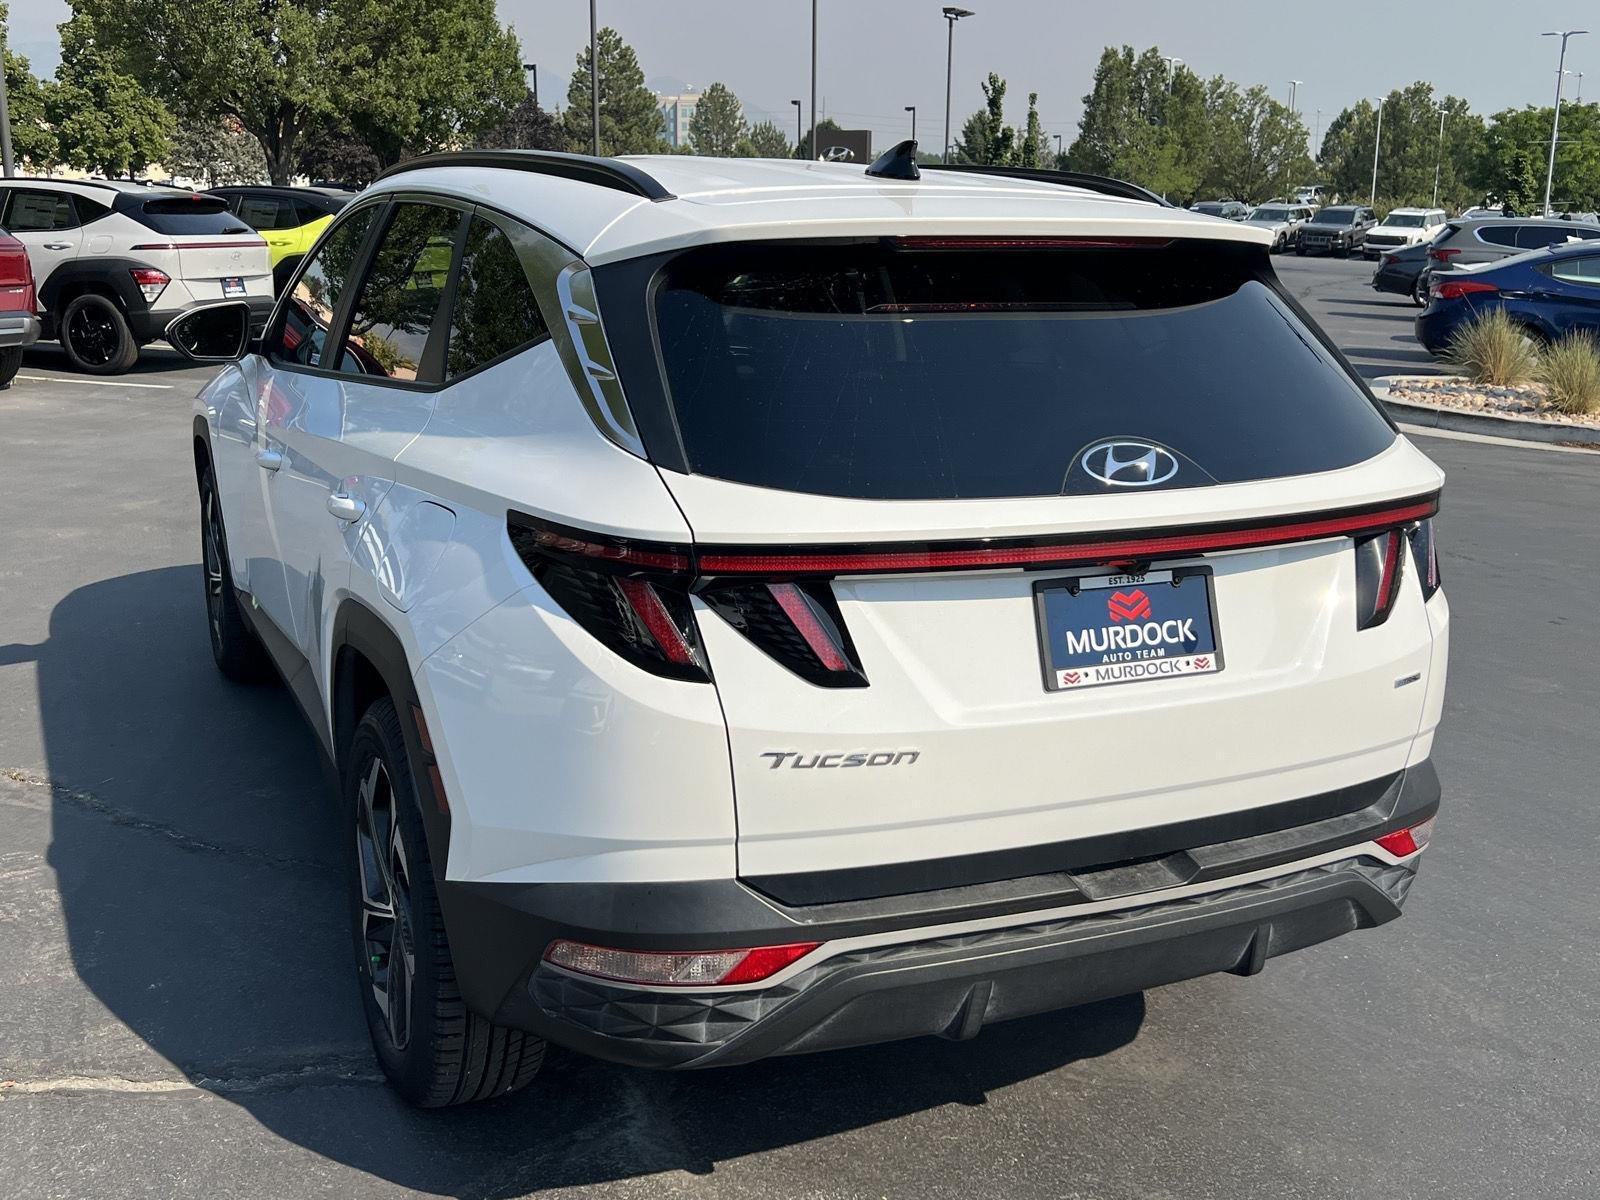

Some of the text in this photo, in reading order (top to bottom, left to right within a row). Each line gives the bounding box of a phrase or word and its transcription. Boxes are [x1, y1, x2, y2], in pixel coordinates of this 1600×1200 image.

[1108, 574, 1145, 586] EST. 1925
[1066, 618, 1197, 654] MURDOCK
[1102, 647, 1165, 663] AUTO TEAM
[1096, 660, 1182, 681] MURDOCK
